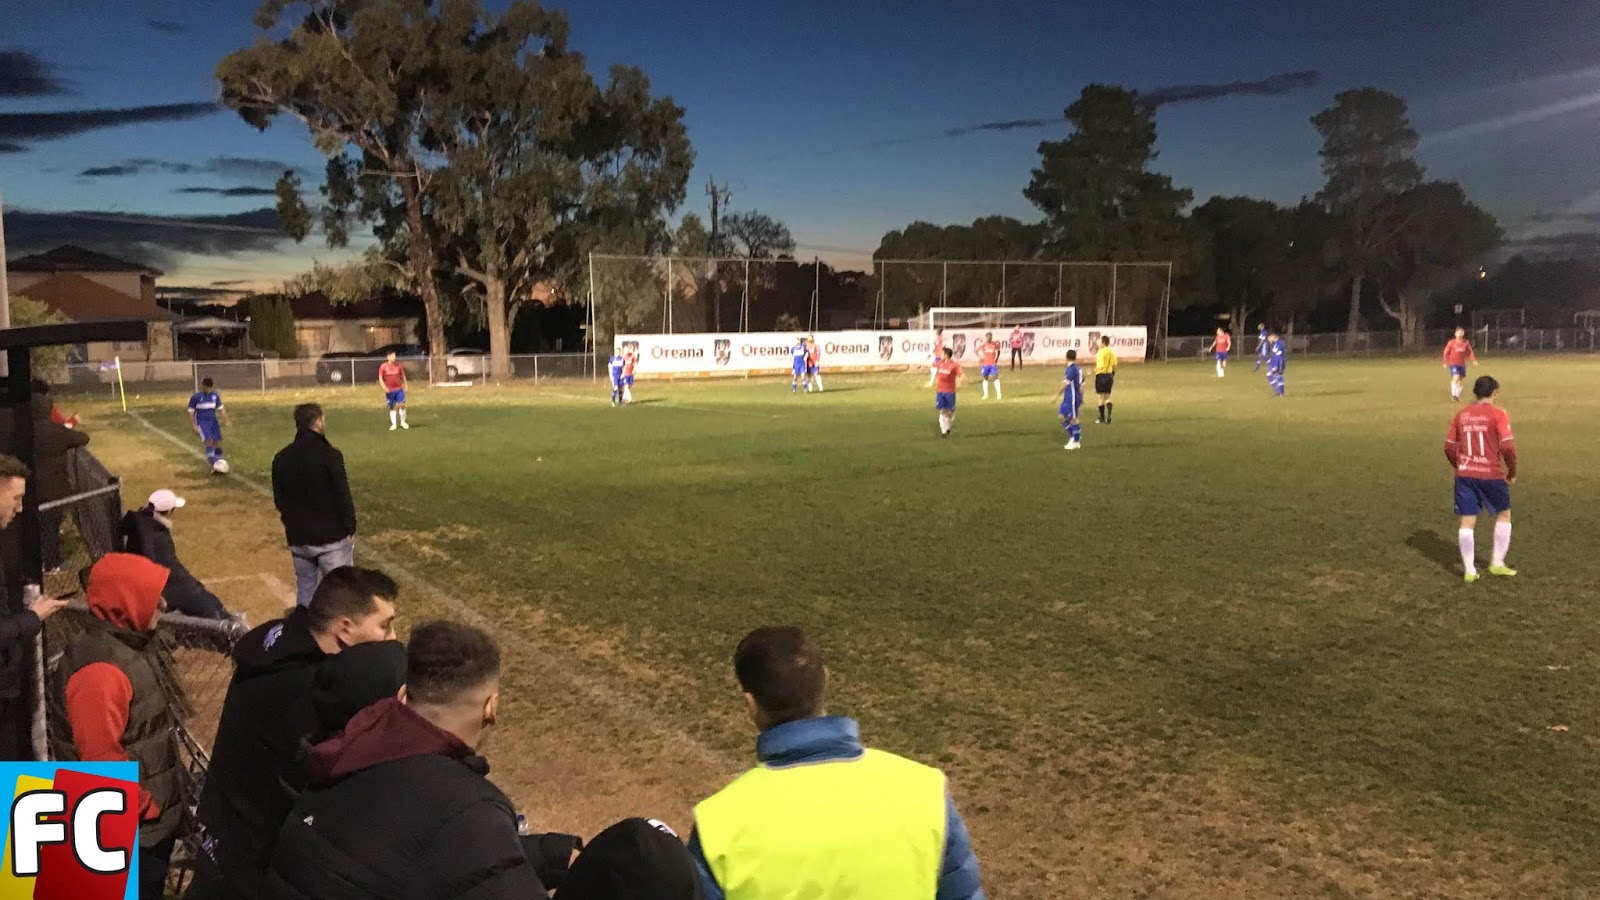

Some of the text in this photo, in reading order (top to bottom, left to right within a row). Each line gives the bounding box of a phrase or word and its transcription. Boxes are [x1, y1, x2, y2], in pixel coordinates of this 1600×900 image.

[651, 345, 704, 359] Oreana
[741, 343, 790, 357] Oreana
[825, 341, 870, 354] Oreana
[1466, 430, 1485, 457] 11
